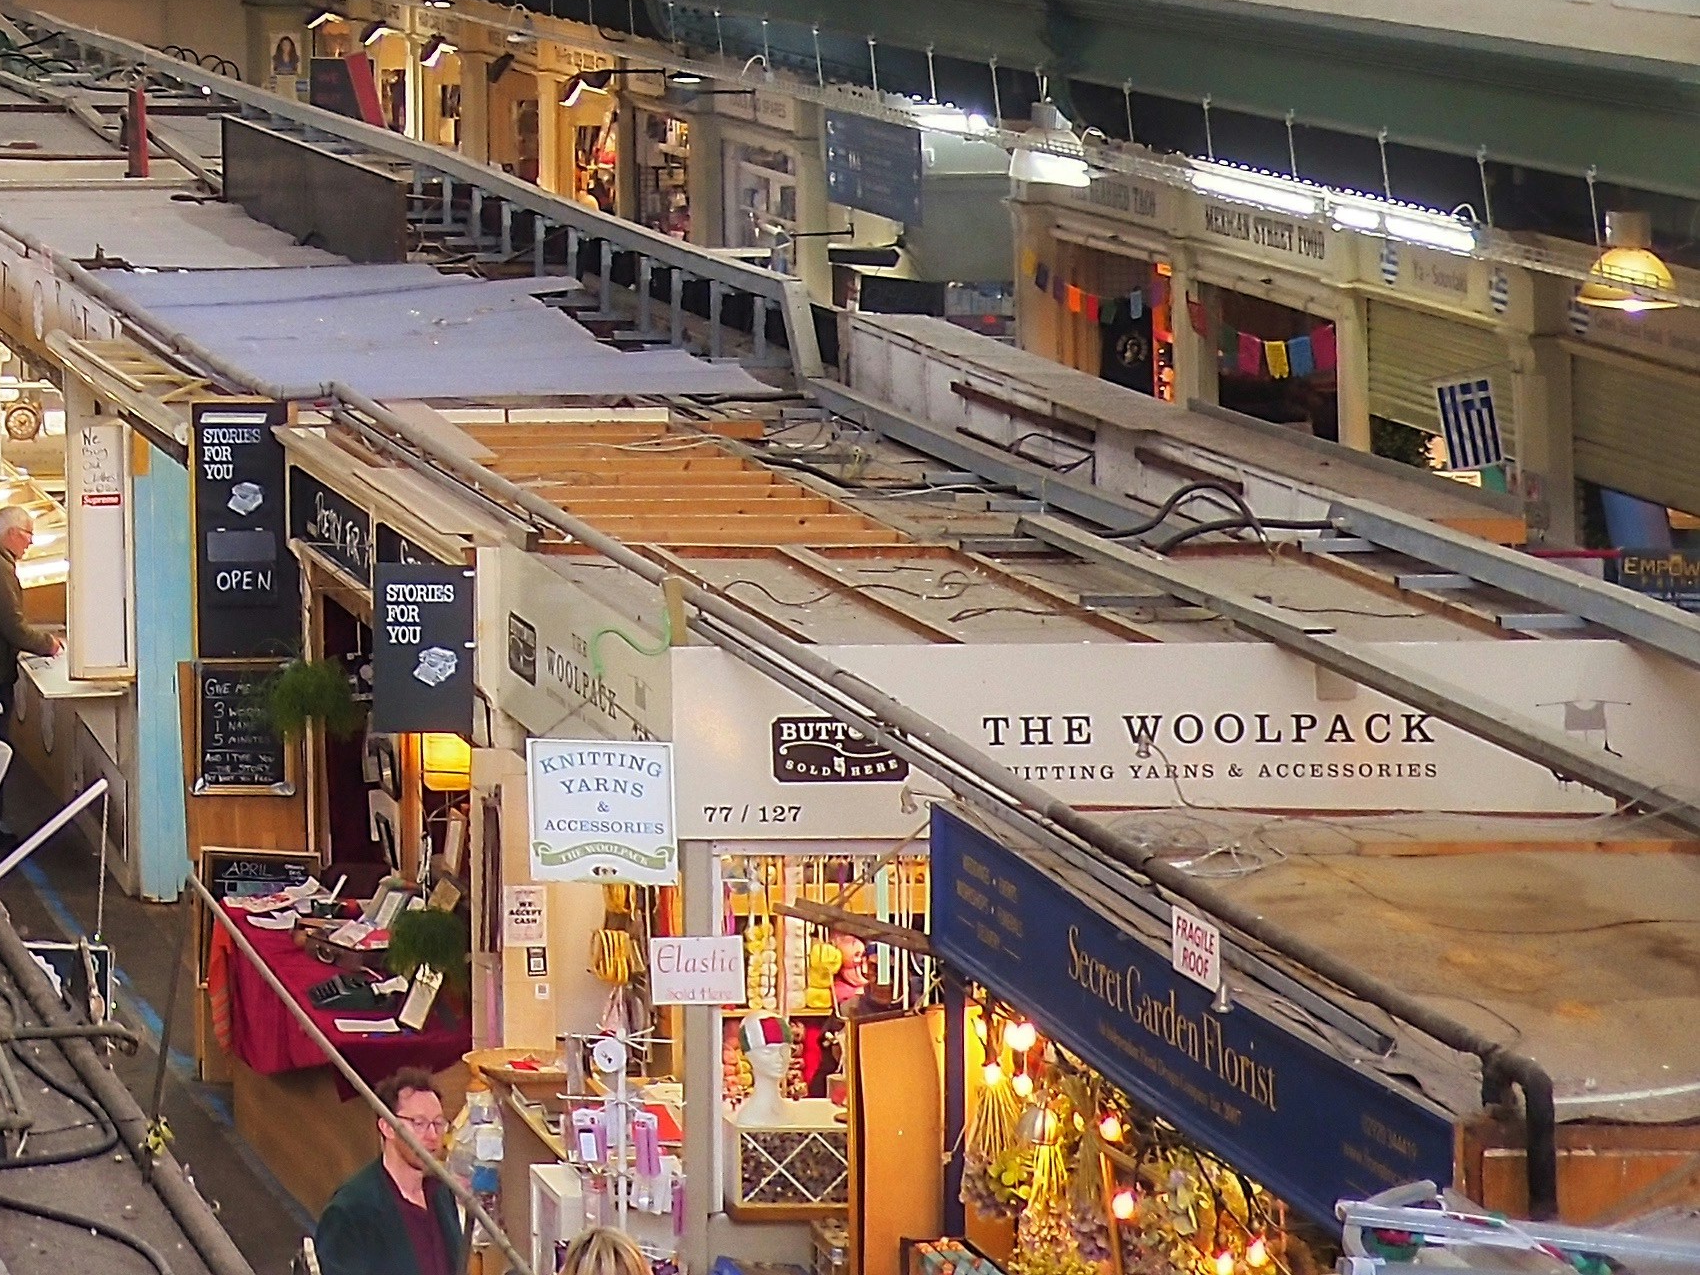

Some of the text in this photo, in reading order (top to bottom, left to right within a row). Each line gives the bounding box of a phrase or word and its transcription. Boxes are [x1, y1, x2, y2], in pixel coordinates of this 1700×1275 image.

[1205, 203, 1326, 260] MEXICAN STREET FOOD
[203, 427, 262, 444] STORIES
[203, 445, 232, 462] FOR
[203, 463, 233, 480] YOU
[216, 569, 272, 591] OPEN
[386, 583, 455, 603] STORIES
[386, 604, 420, 623] FOR
[386, 625, 422, 644] YOU
[546, 645, 618, 721] WOOLPACK
[213, 701, 226, 719] 3
[983, 713, 1437, 746] THE WOOLPACK
[212, 733, 225, 747] 5
[539, 751, 663, 779] KNITTING
[785, 758, 899, 777] SOLD HERE
[1130, 763, 1216, 780] YARNS
[1227, 764, 1244, 779] &
[1258, 762, 1439, 779] ACCESSORIES
[560, 777, 645, 799] YARNS
[597, 800, 610, 814] &
[704, 806, 733, 823] 77
[758, 806, 802, 823] 127
[544, 819, 665, 835] ACCESSORIES
[583, 844, 650, 866] WOOLPACK
[225, 861, 274, 879] APRIL
[509, 909, 543, 917] ACCEPT
[514, 917, 538, 925] CASH
[1175, 915, 1216, 955] FRAGILE
[657, 944, 739, 974] Elastic
[1180, 942, 1211, 980] ROOF
[1067, 924, 1126, 1014] Secret
[1126, 965, 1200, 1063] Garden
[1201, 1012, 1279, 1113] Florist
